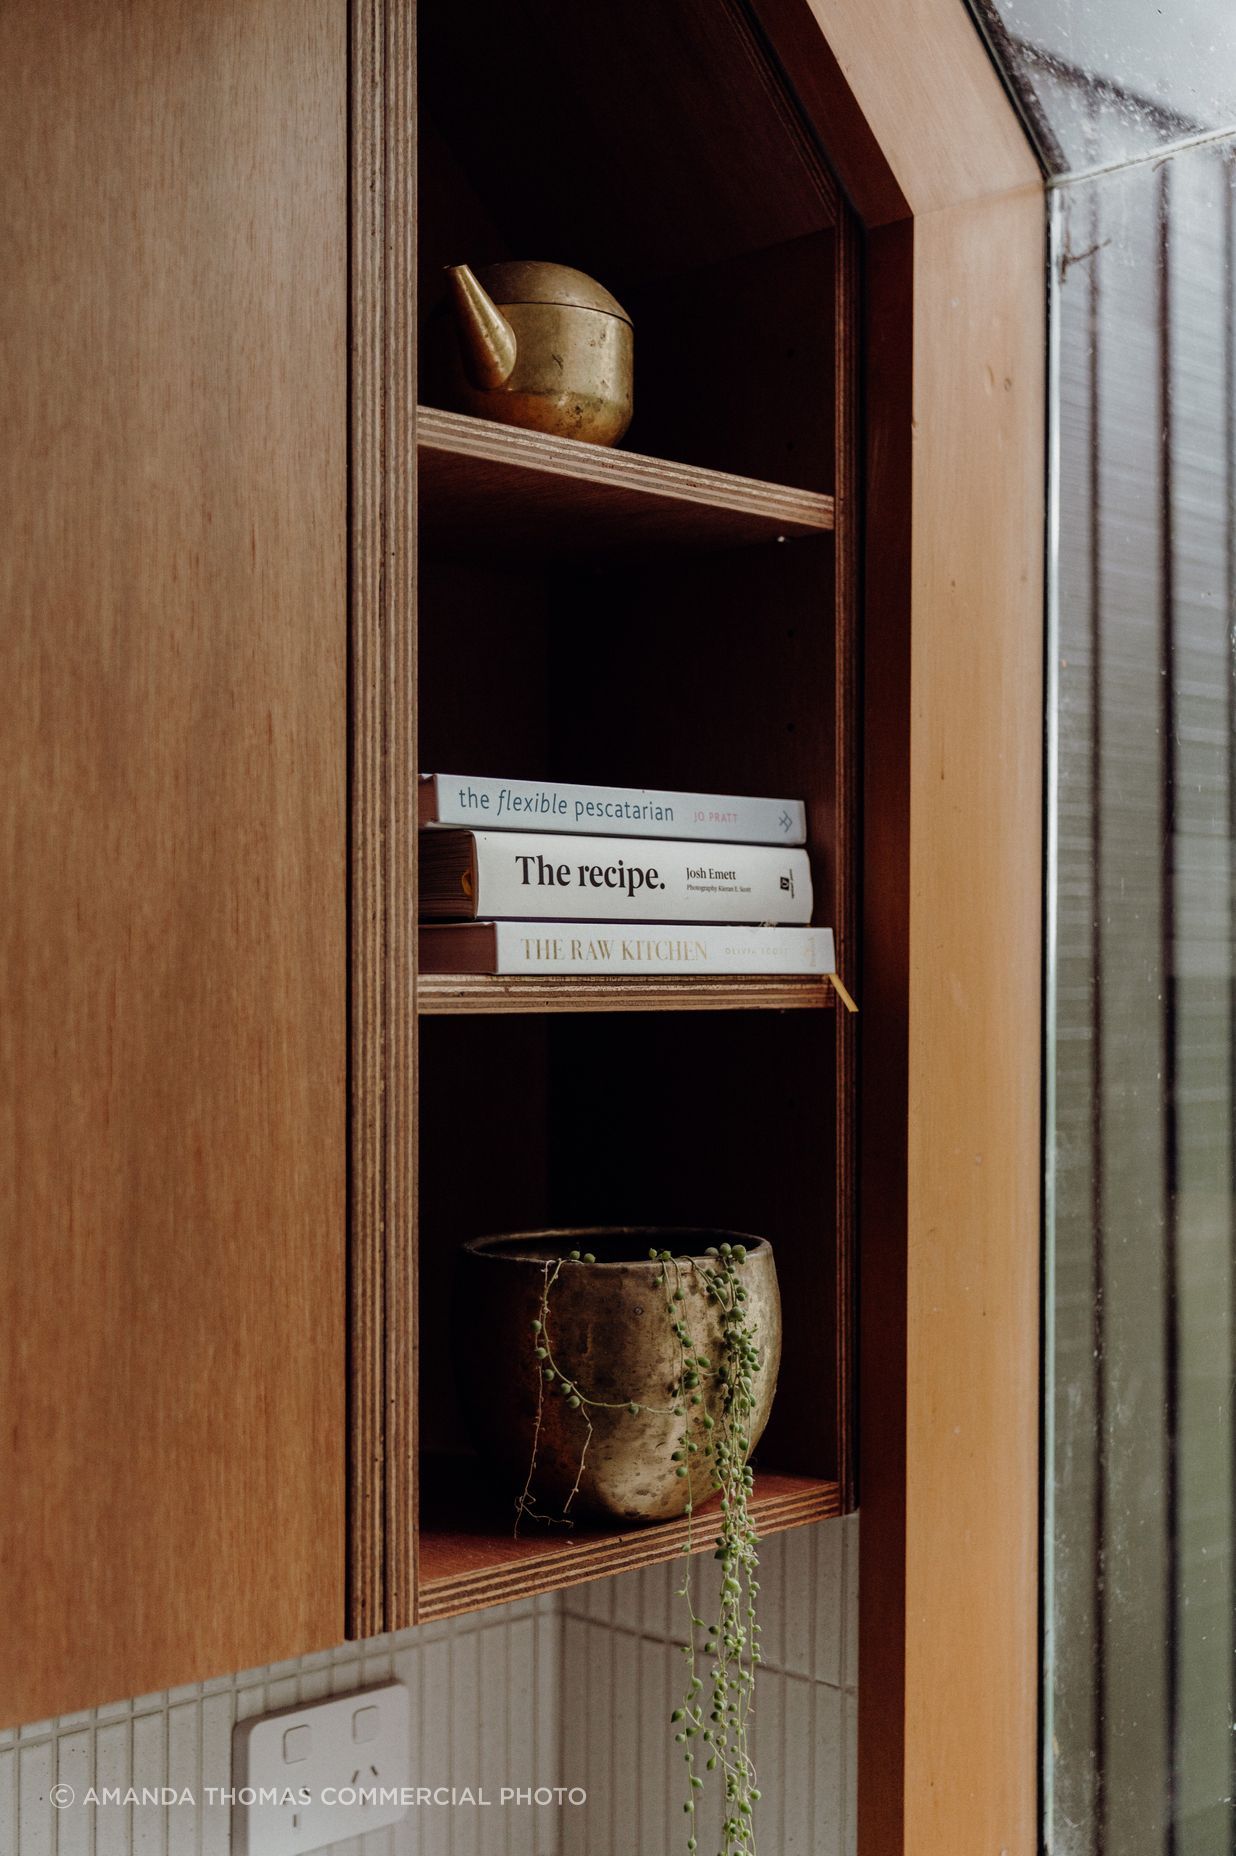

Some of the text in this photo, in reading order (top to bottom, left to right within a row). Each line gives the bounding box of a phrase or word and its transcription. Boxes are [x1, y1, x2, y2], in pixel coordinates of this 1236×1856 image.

[458, 786, 674, 822] the flexible pescatarian
[694, 811, 737, 824] JO PRATT
[515, 854, 666, 897] The recipe.
[686, 867, 736, 880] Josh Emett
[520, 938, 708, 961] THE RAW KITCHEN
